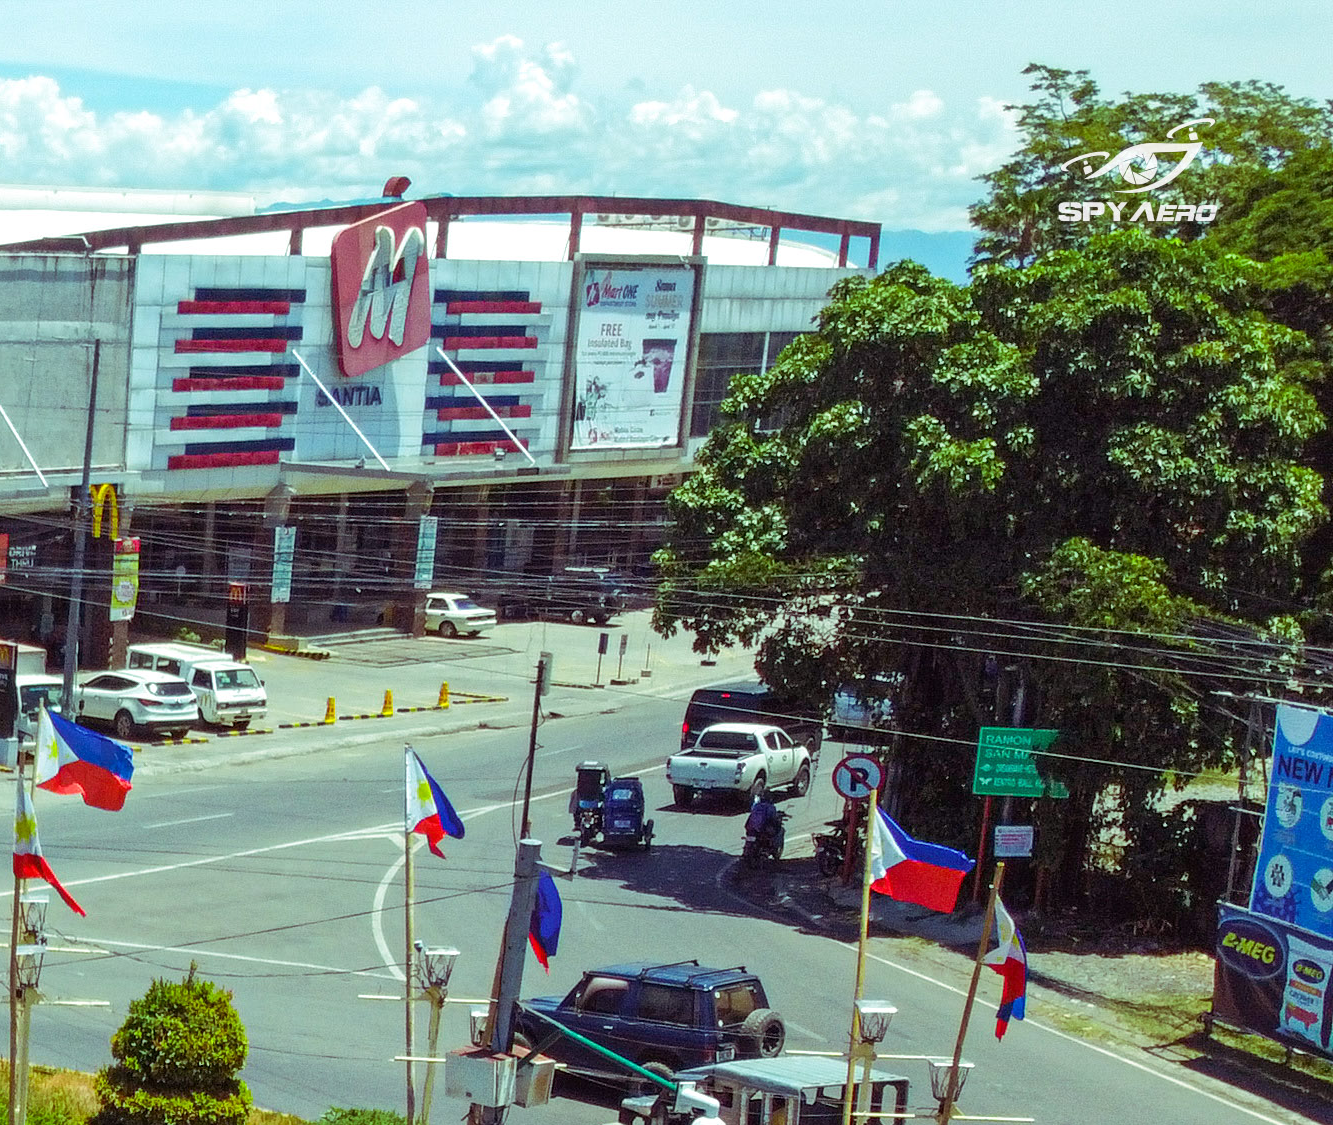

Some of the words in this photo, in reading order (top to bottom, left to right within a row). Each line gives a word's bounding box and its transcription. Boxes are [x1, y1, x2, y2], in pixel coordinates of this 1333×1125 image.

[623, 284, 639, 299] ONE
[601, 323, 622, 336] FREE
[986, 735, 1032, 745] RAMON
[1278, 754, 1323, 784] NEW
